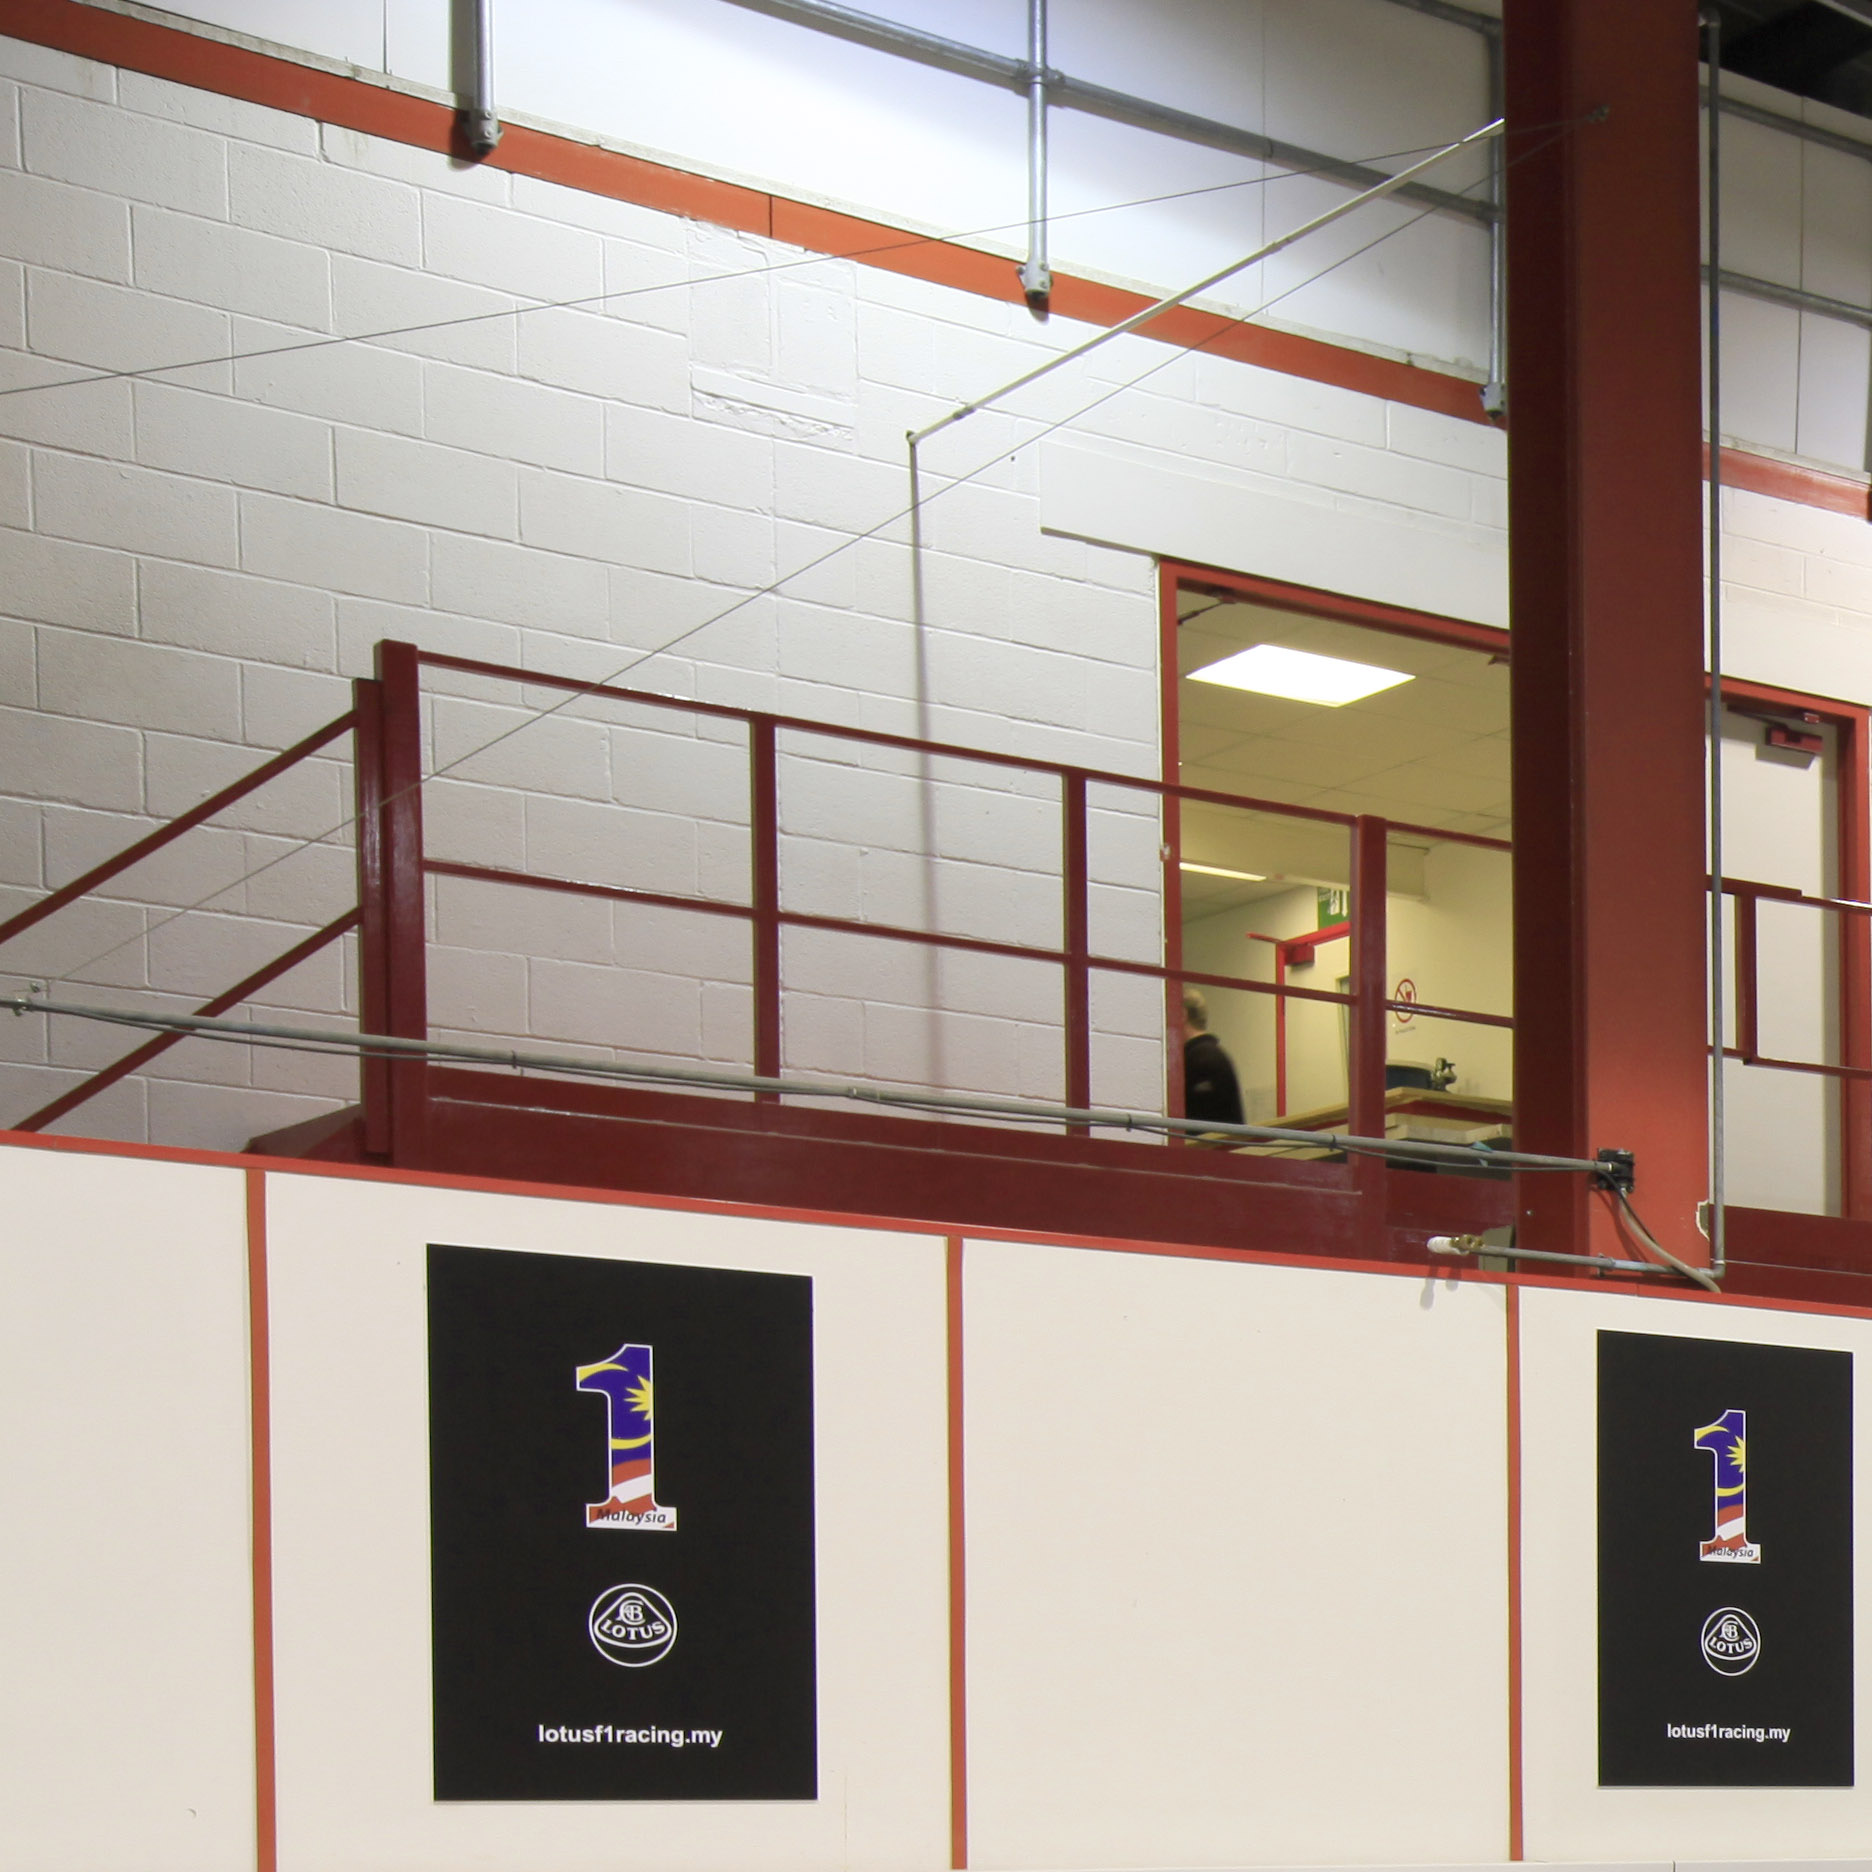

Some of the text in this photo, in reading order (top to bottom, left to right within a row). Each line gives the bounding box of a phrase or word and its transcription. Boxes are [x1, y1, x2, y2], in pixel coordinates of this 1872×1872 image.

[576, 1343, 677, 1531] 1
[1694, 1409, 1761, 1564] 1
[597, 1507, 666, 1525] Malaysia
[1708, 1544, 1754, 1559] Malaysia
[600, 1618, 666, 1641] LOTUS
[1708, 1636, 1754, 1653] LOTUS
[538, 1724, 723, 1748] lotusf1racing.my
[1667, 1723, 1790, 1743] lotusf1racing.my
